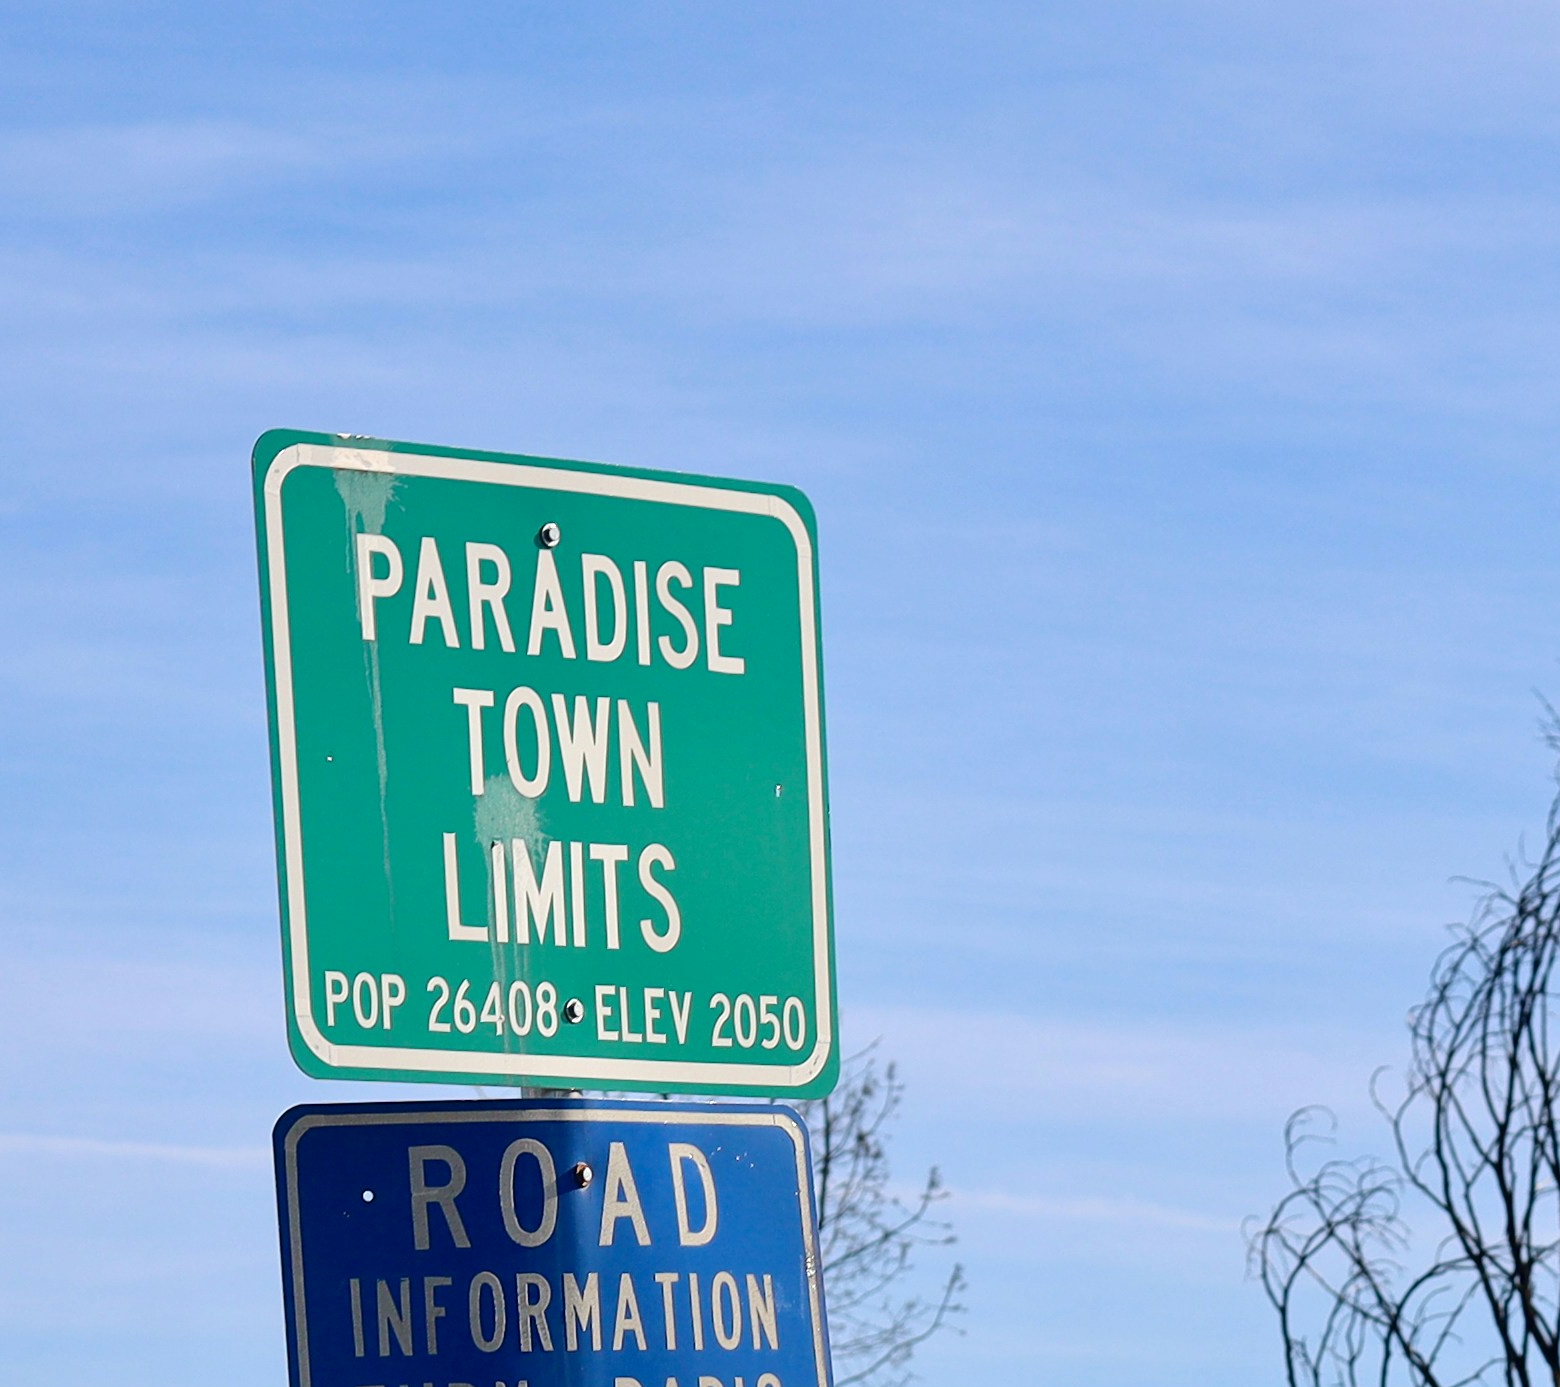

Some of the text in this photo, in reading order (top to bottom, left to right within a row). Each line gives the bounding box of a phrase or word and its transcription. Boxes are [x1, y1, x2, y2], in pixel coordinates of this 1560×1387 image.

[355, 533, 745, 676] PARADISE
[453, 686, 664, 808] TOWN
[443, 832, 681, 953] LIMITS
[325, 970, 806, 1051] POP 26408 ELEV 2050
[407, 1138, 719, 1250] ROAD
[350, 1271, 779, 1357] INFORMATION
